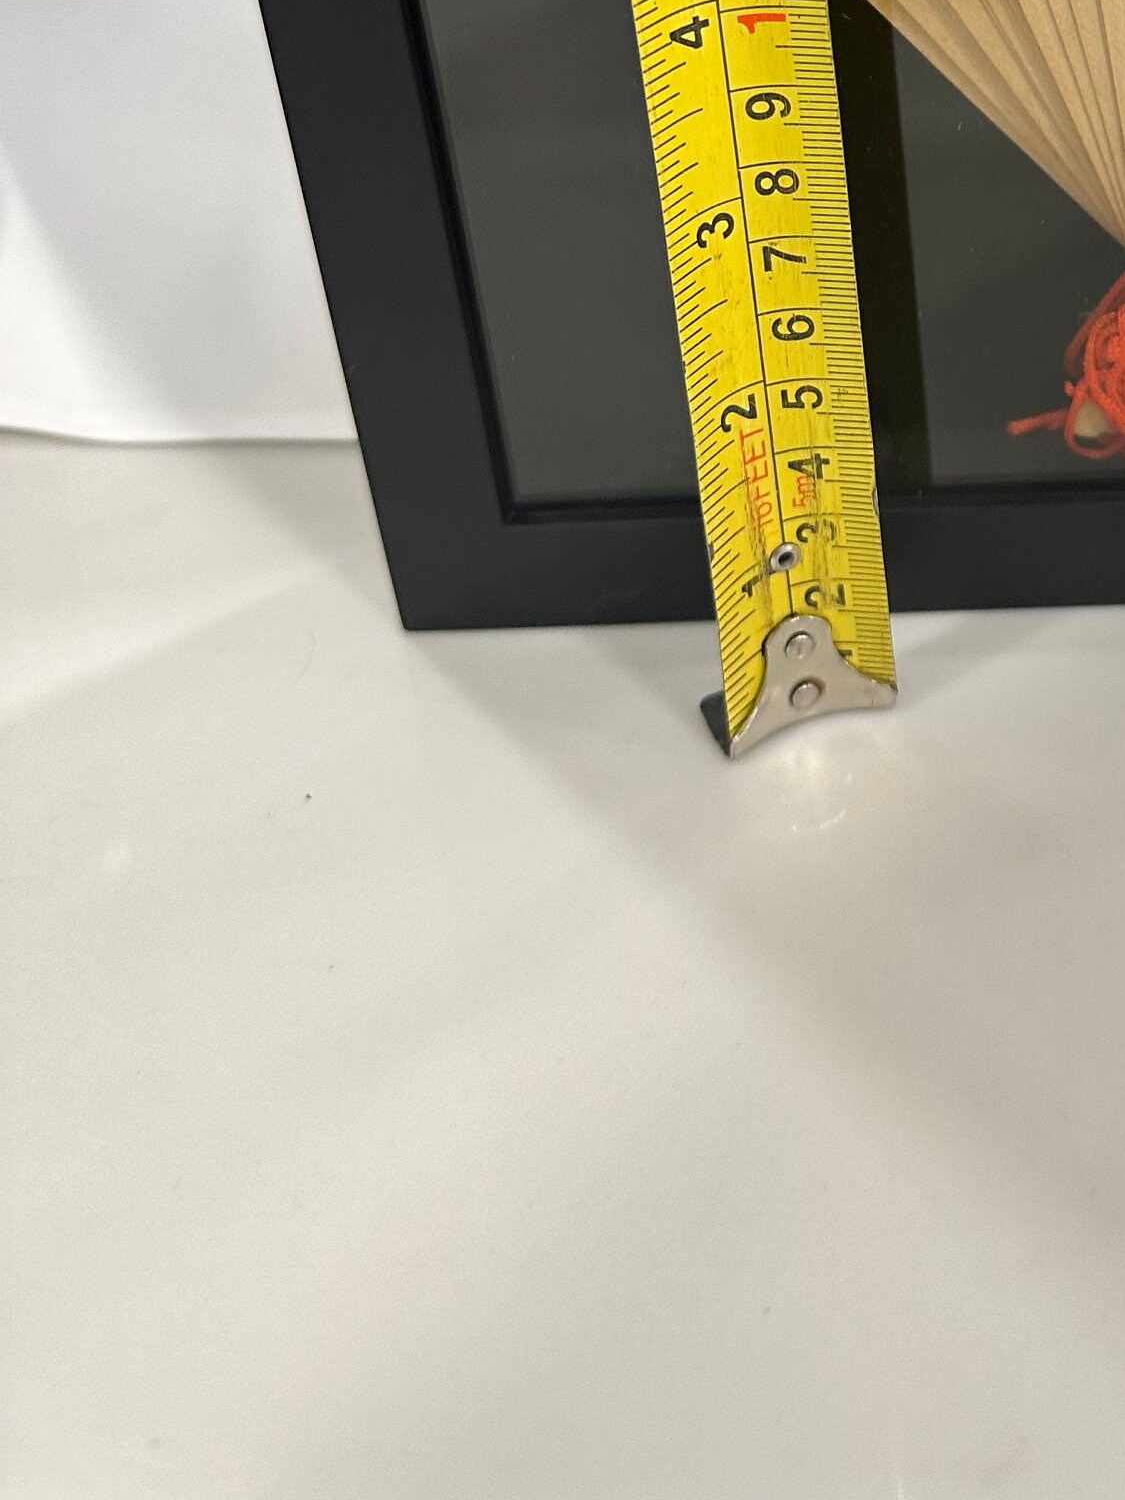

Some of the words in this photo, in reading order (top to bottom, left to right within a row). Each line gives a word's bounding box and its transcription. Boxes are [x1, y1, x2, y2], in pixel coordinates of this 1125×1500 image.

[670, 16, 710, 49] 4
[745, 92, 791, 120] 9
[755, 168, 800, 196] 8
[697, 212, 735, 248] 3
[762, 245, 807, 272] 7
[772, 314, 815, 341] 6
[781, 385, 823, 409] 5
[721, 394, 758, 432] 2
[788, 453, 830, 479] 4
